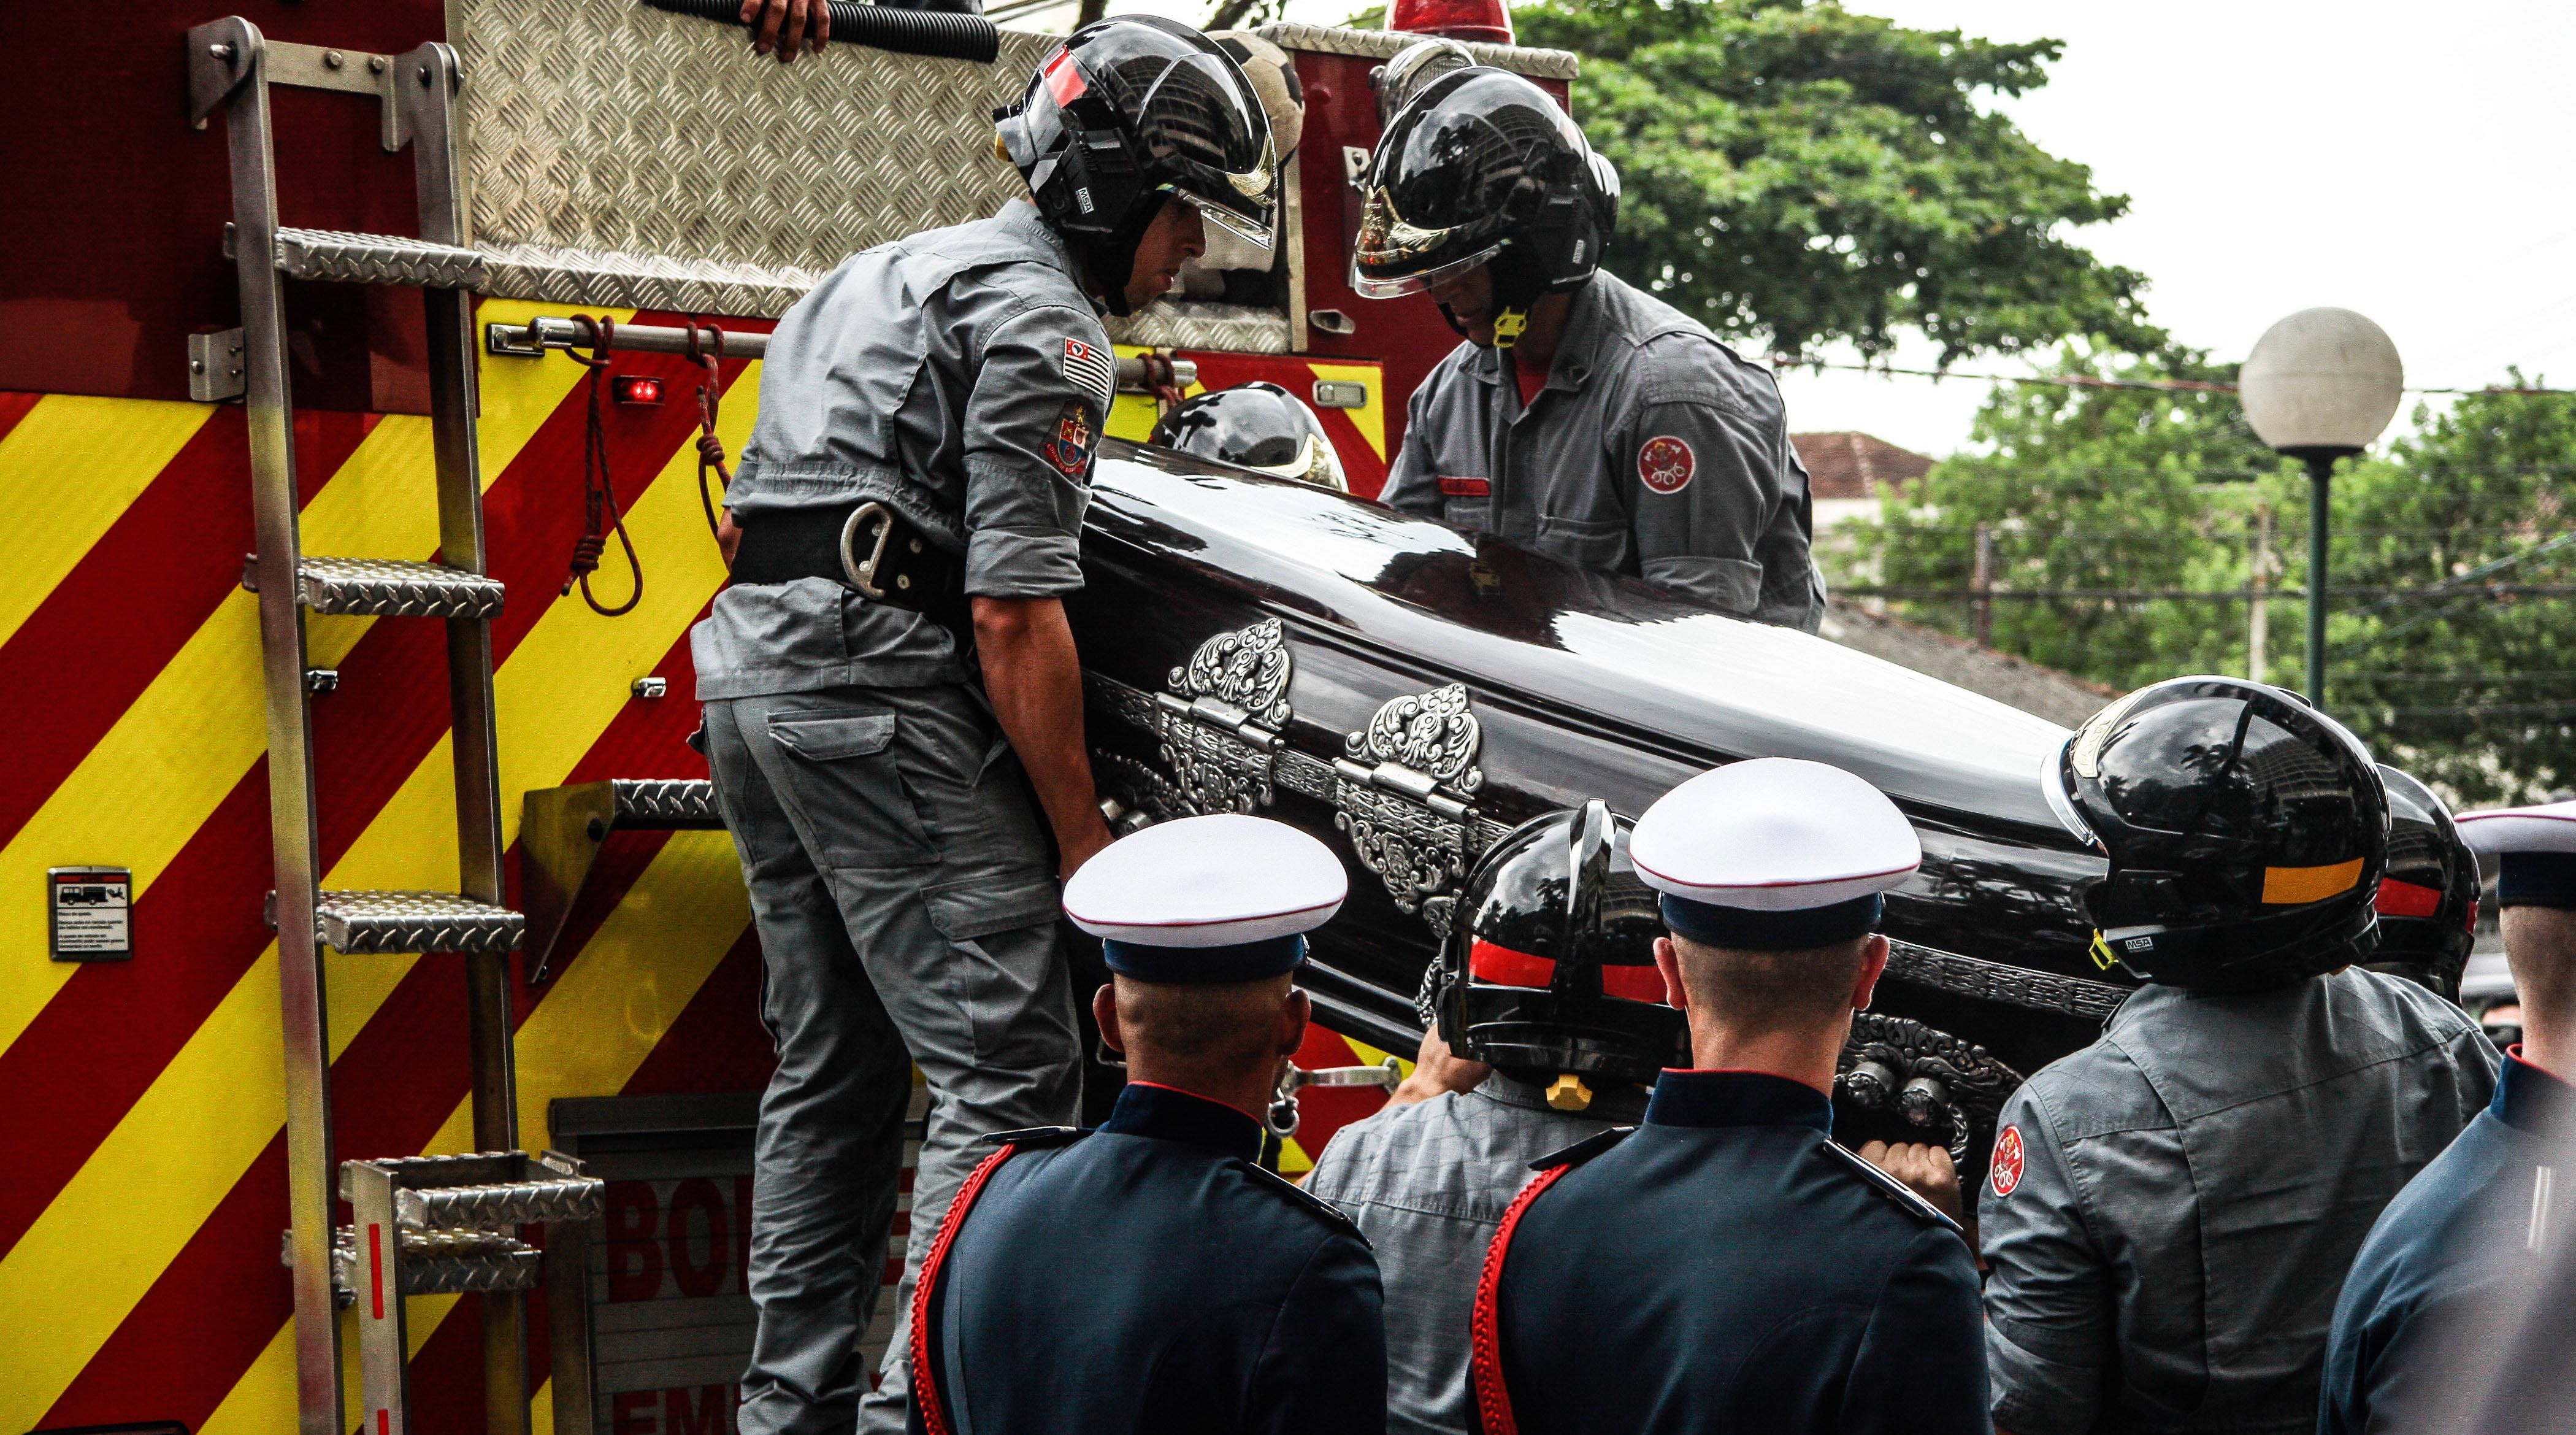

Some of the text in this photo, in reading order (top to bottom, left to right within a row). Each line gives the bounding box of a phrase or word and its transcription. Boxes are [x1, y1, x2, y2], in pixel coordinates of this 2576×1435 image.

[1079, 188, 1092, 212] MSA
[2127, 939, 2152, 949] MSA
[605, 1174, 753, 1304] BO
[613, 1383, 741, 1435] EM
